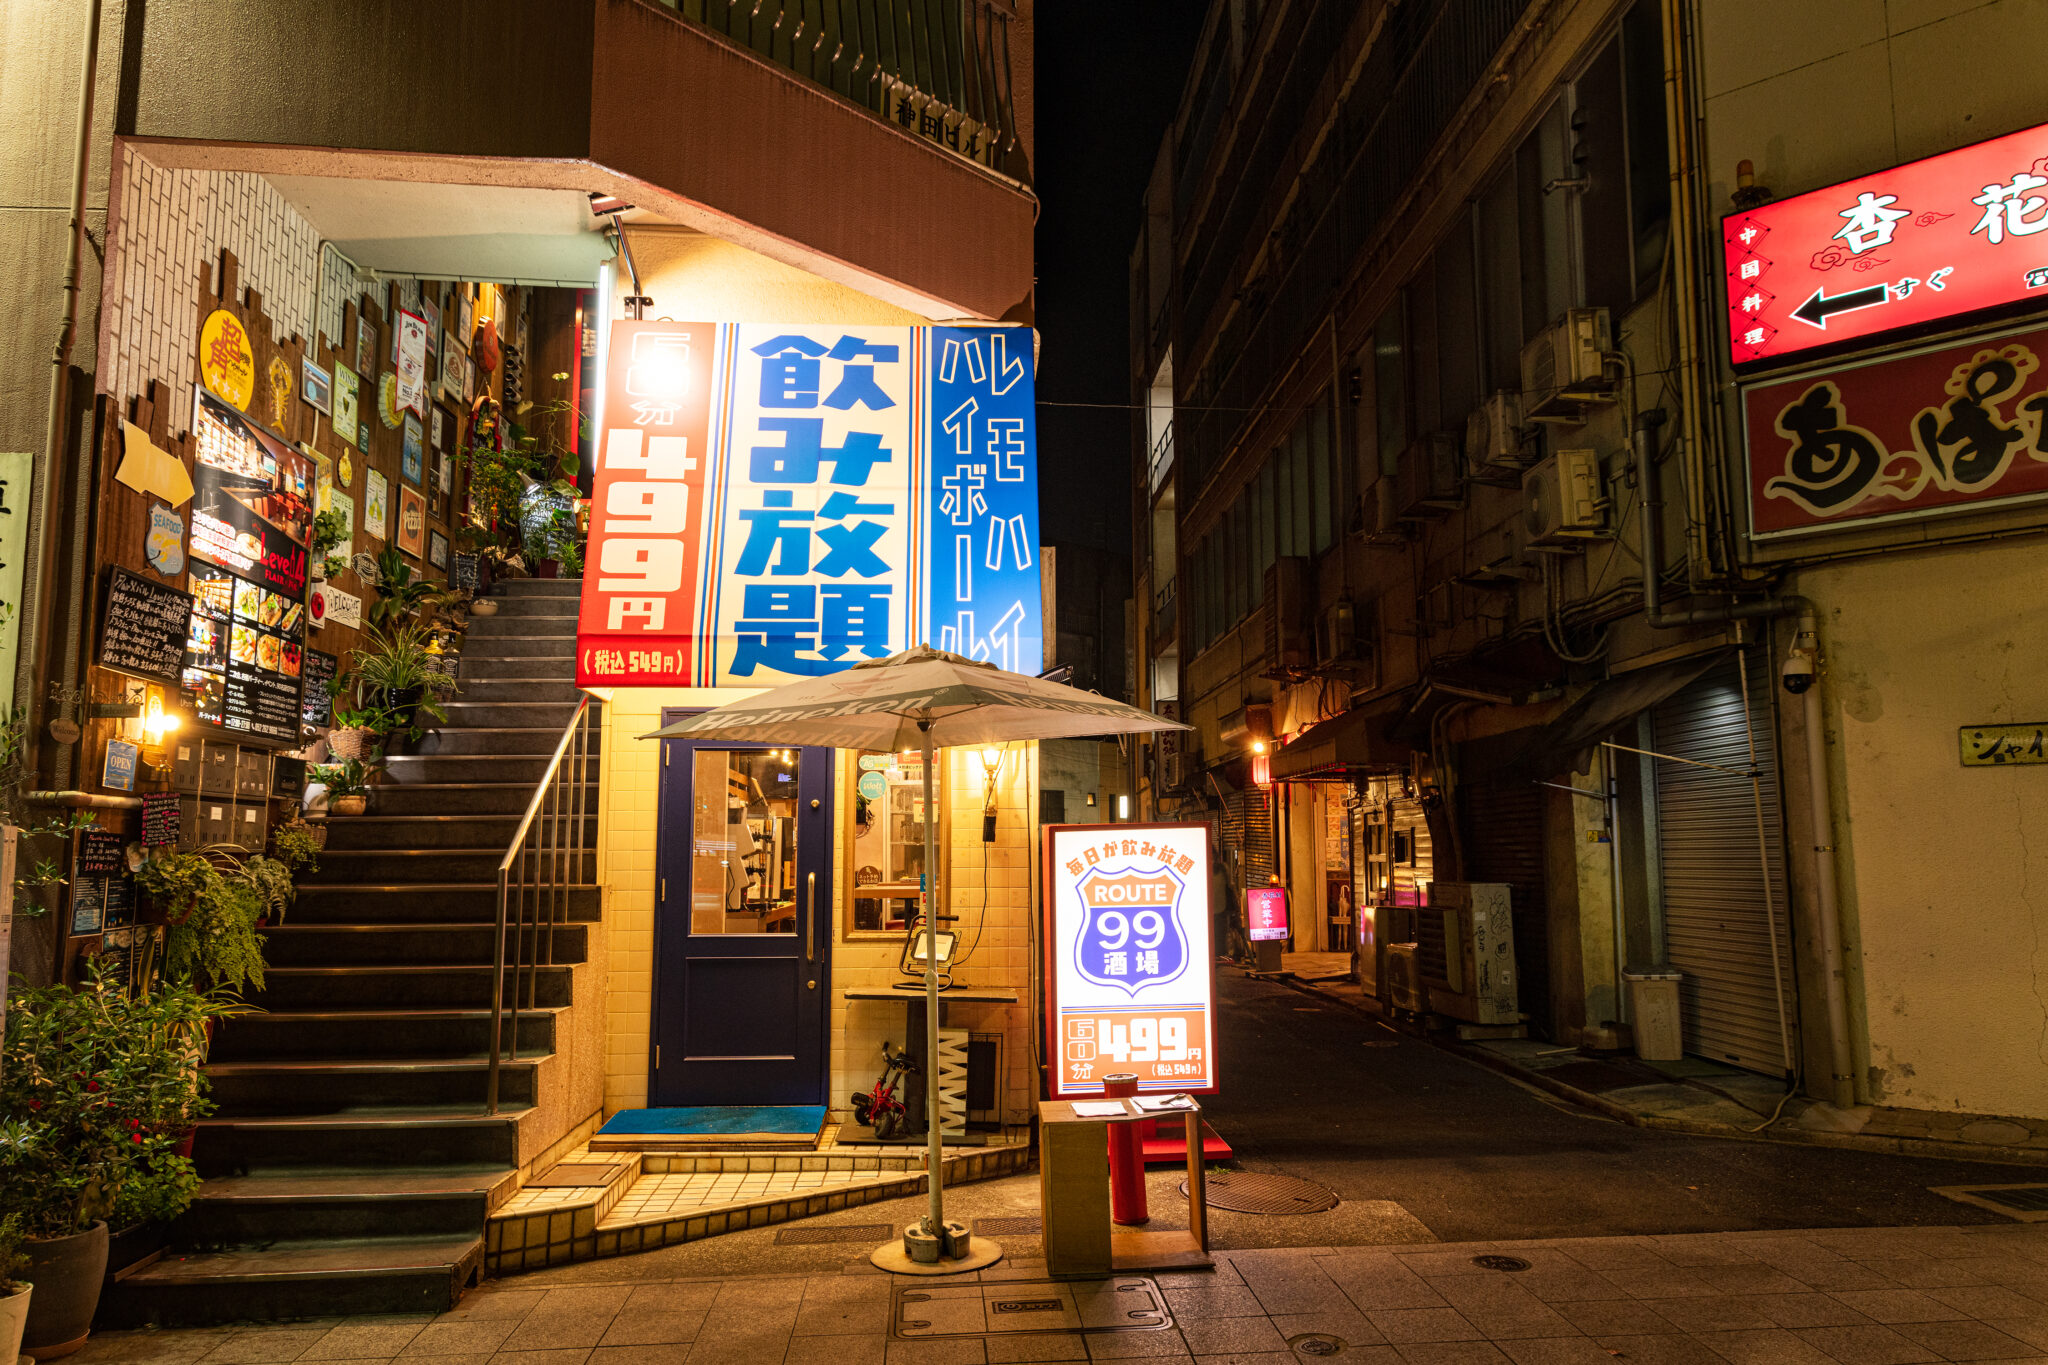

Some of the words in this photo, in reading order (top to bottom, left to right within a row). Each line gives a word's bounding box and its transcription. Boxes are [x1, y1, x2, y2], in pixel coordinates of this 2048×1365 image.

[1739, 226, 1765, 345] 中国料理
[1888, 266, 1954, 300] すぐ
[339, 367, 356, 388] WINE
[1765, 346, 2048, 514] あっぱ
[729, 334, 899, 677] 飲み放題
[154, 513, 181, 535] SEAFOOD
[598, 428, 697, 631] 499円
[264, 568, 285, 585] FLAIR
[327, 589, 360, 612] WELCOME
[583, 649, 684, 676] (税込549円)
[685, 695, 934, 733] Heineken
[110, 755, 132, 771] OPEN
[1065, 838, 1196, 877] 毎日が飲み放題
[1094, 884, 1167, 903] ROUTE
[1261, 899, 1273, 928] 営業中
[1096, 910, 1166, 950] 99
[1103, 950, 1160, 976] 酒場
[1067, 1018, 1097, 1080] 60分
[1098, 1017, 1202, 1063] 499円
[1151, 1062, 1202, 1077] (税込549円)
